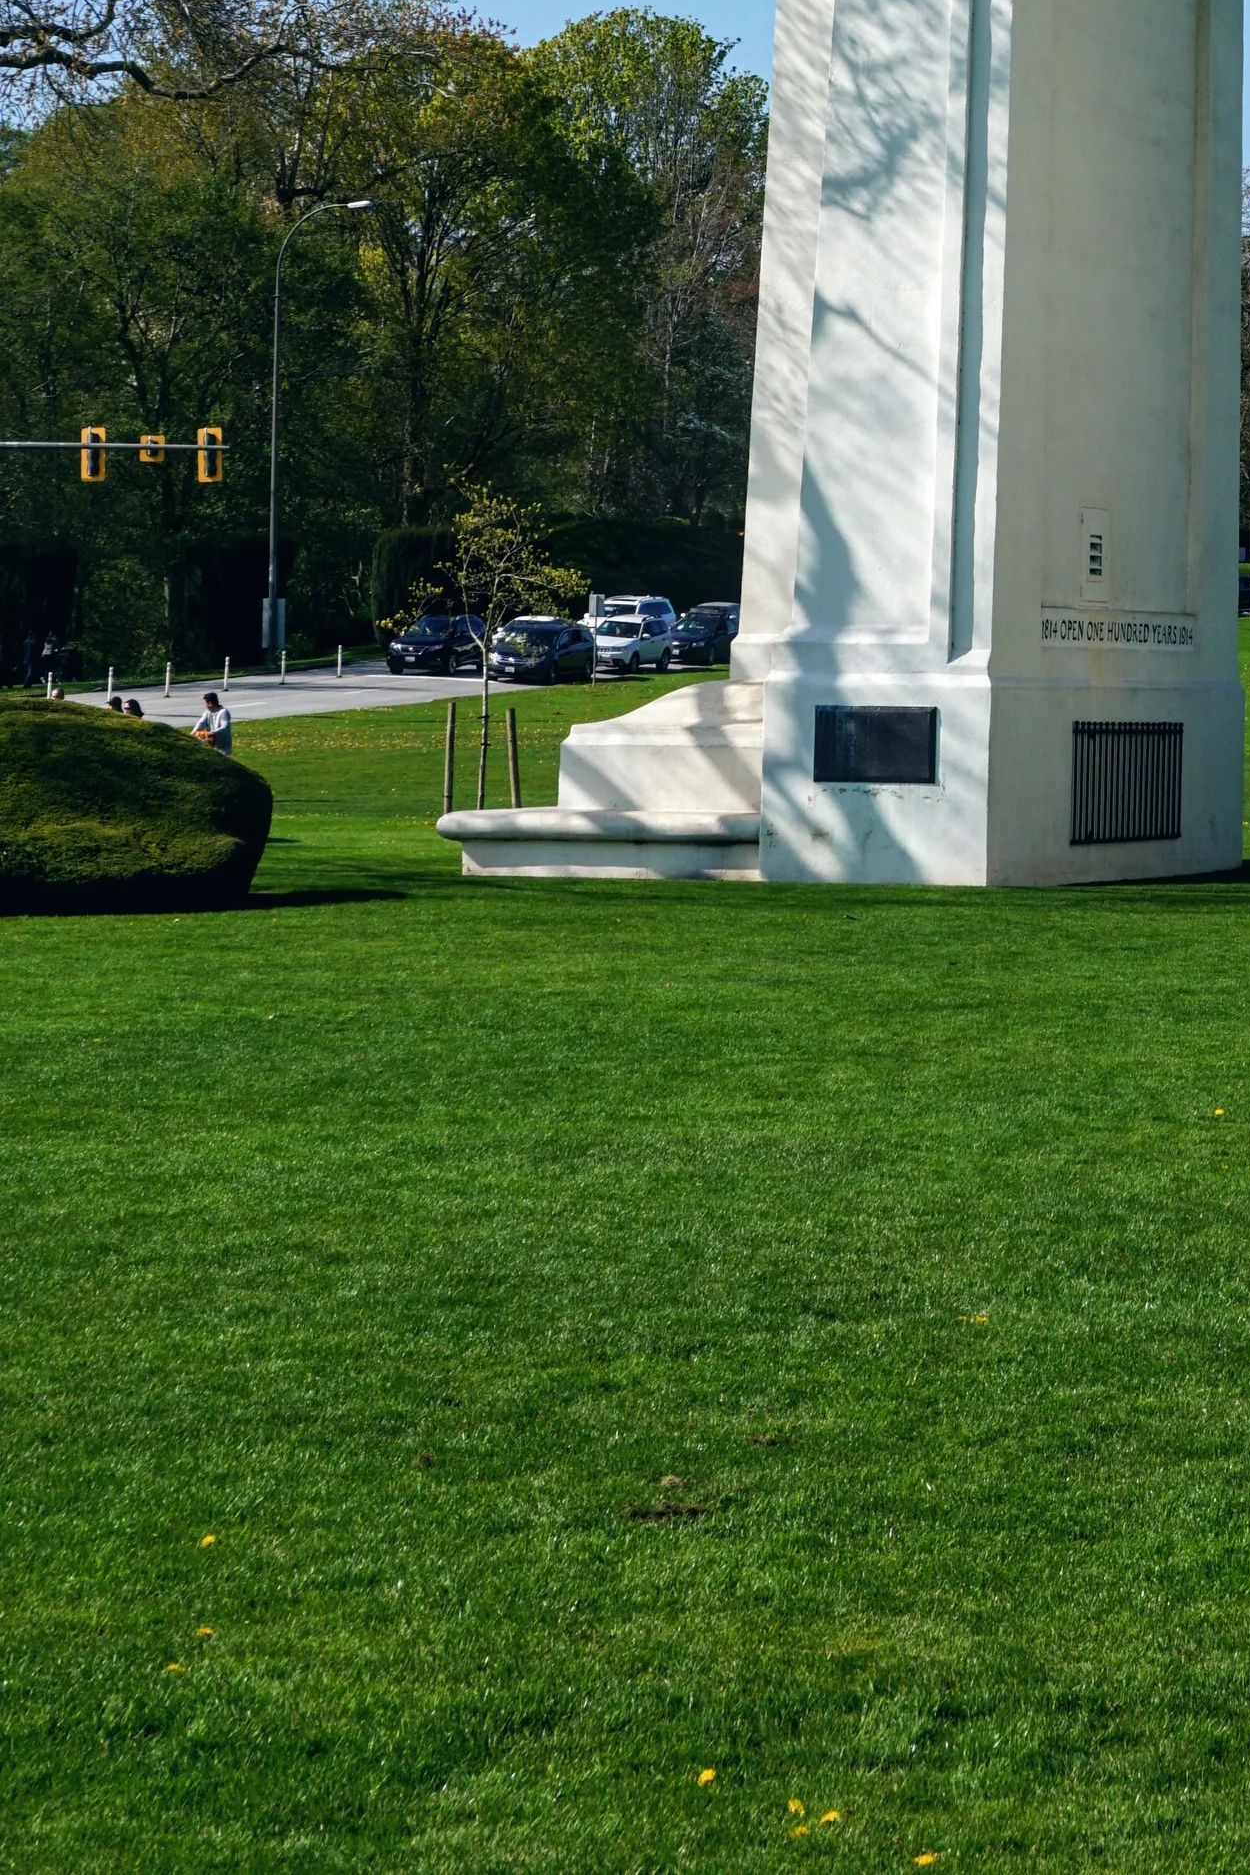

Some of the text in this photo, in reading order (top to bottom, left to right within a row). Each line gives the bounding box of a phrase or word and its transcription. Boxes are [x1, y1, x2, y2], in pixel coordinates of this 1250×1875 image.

[1041, 619, 1194, 645] 1814 OPEN ONE HUNDRED YEARS 1914
